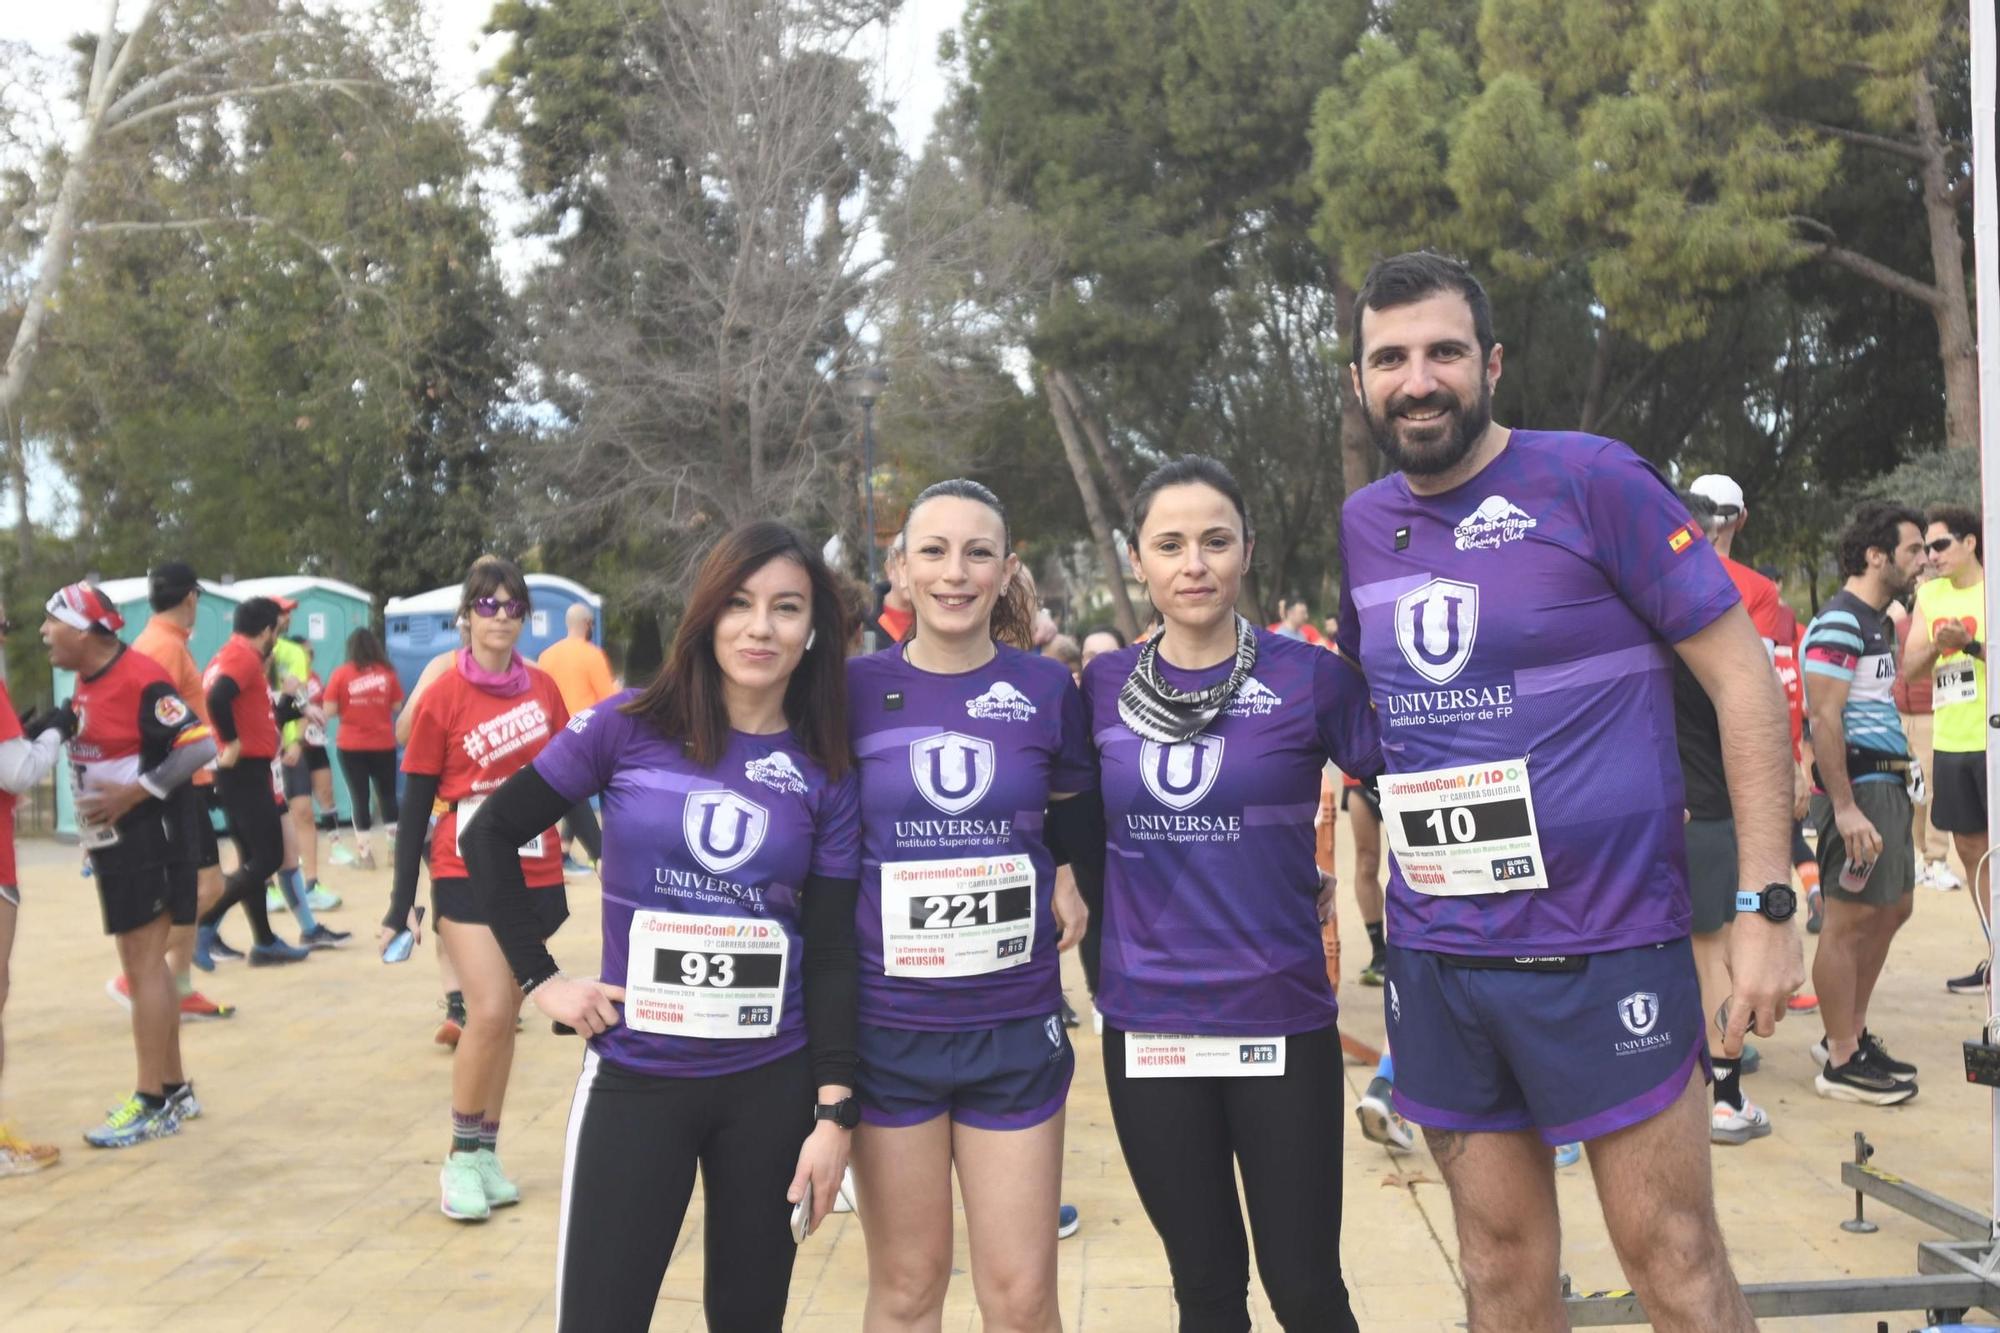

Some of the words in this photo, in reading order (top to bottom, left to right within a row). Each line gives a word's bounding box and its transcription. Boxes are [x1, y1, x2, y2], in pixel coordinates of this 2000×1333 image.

[1502, 527, 1525, 542] Club
[1387, 684, 1513, 715] UNIVERSAE
[1012, 709, 1030, 722] Club
[1252, 703, 1272, 715] Club
[1390, 714, 1426, 727] Instituto
[1428, 711, 1476, 726] Superior
[1478, 709, 1494, 720] de
[1496, 706, 1513, 718] FP
[1450, 791, 1482, 801] CARRERA
[1482, 785, 1521, 798] SOLIDARIA
[895, 820, 1011, 838] UNIVERSAE
[1126, 814, 1241, 831] UNIVERSAE
[1426, 807, 1477, 844] 10
[896, 839, 936, 848] Instituto
[939, 837, 980, 848] Superior
[982, 835, 994, 845] de
[996, 835, 1010, 845] FP
[1129, 831, 1165, 841] Instituto
[1167, 832, 1208, 843] Superior
[1211, 833, 1224, 841] de
[1227, 833, 1240, 841] FP
[1507, 858, 1528, 866] GLOBAL
[968, 879, 998, 889] CARRERA
[999, 875, 1029, 885] SOLIDARIA
[654, 885, 693, 898] Instituto
[695, 892, 736, 905] Superior
[924, 892, 998, 929] 221
[715, 941, 746, 949] CARRERA
[748, 941, 780, 950] SOLIDARIA
[895, 954, 945, 966] INCLUSIÓN
[680, 952, 734, 987] 93
[636, 1007, 684, 1023] INCLUSIÓN
[1615, 1031, 1671, 1051] UNIVERSAE
[1137, 1054, 1186, 1066] INCLUSIÓN
